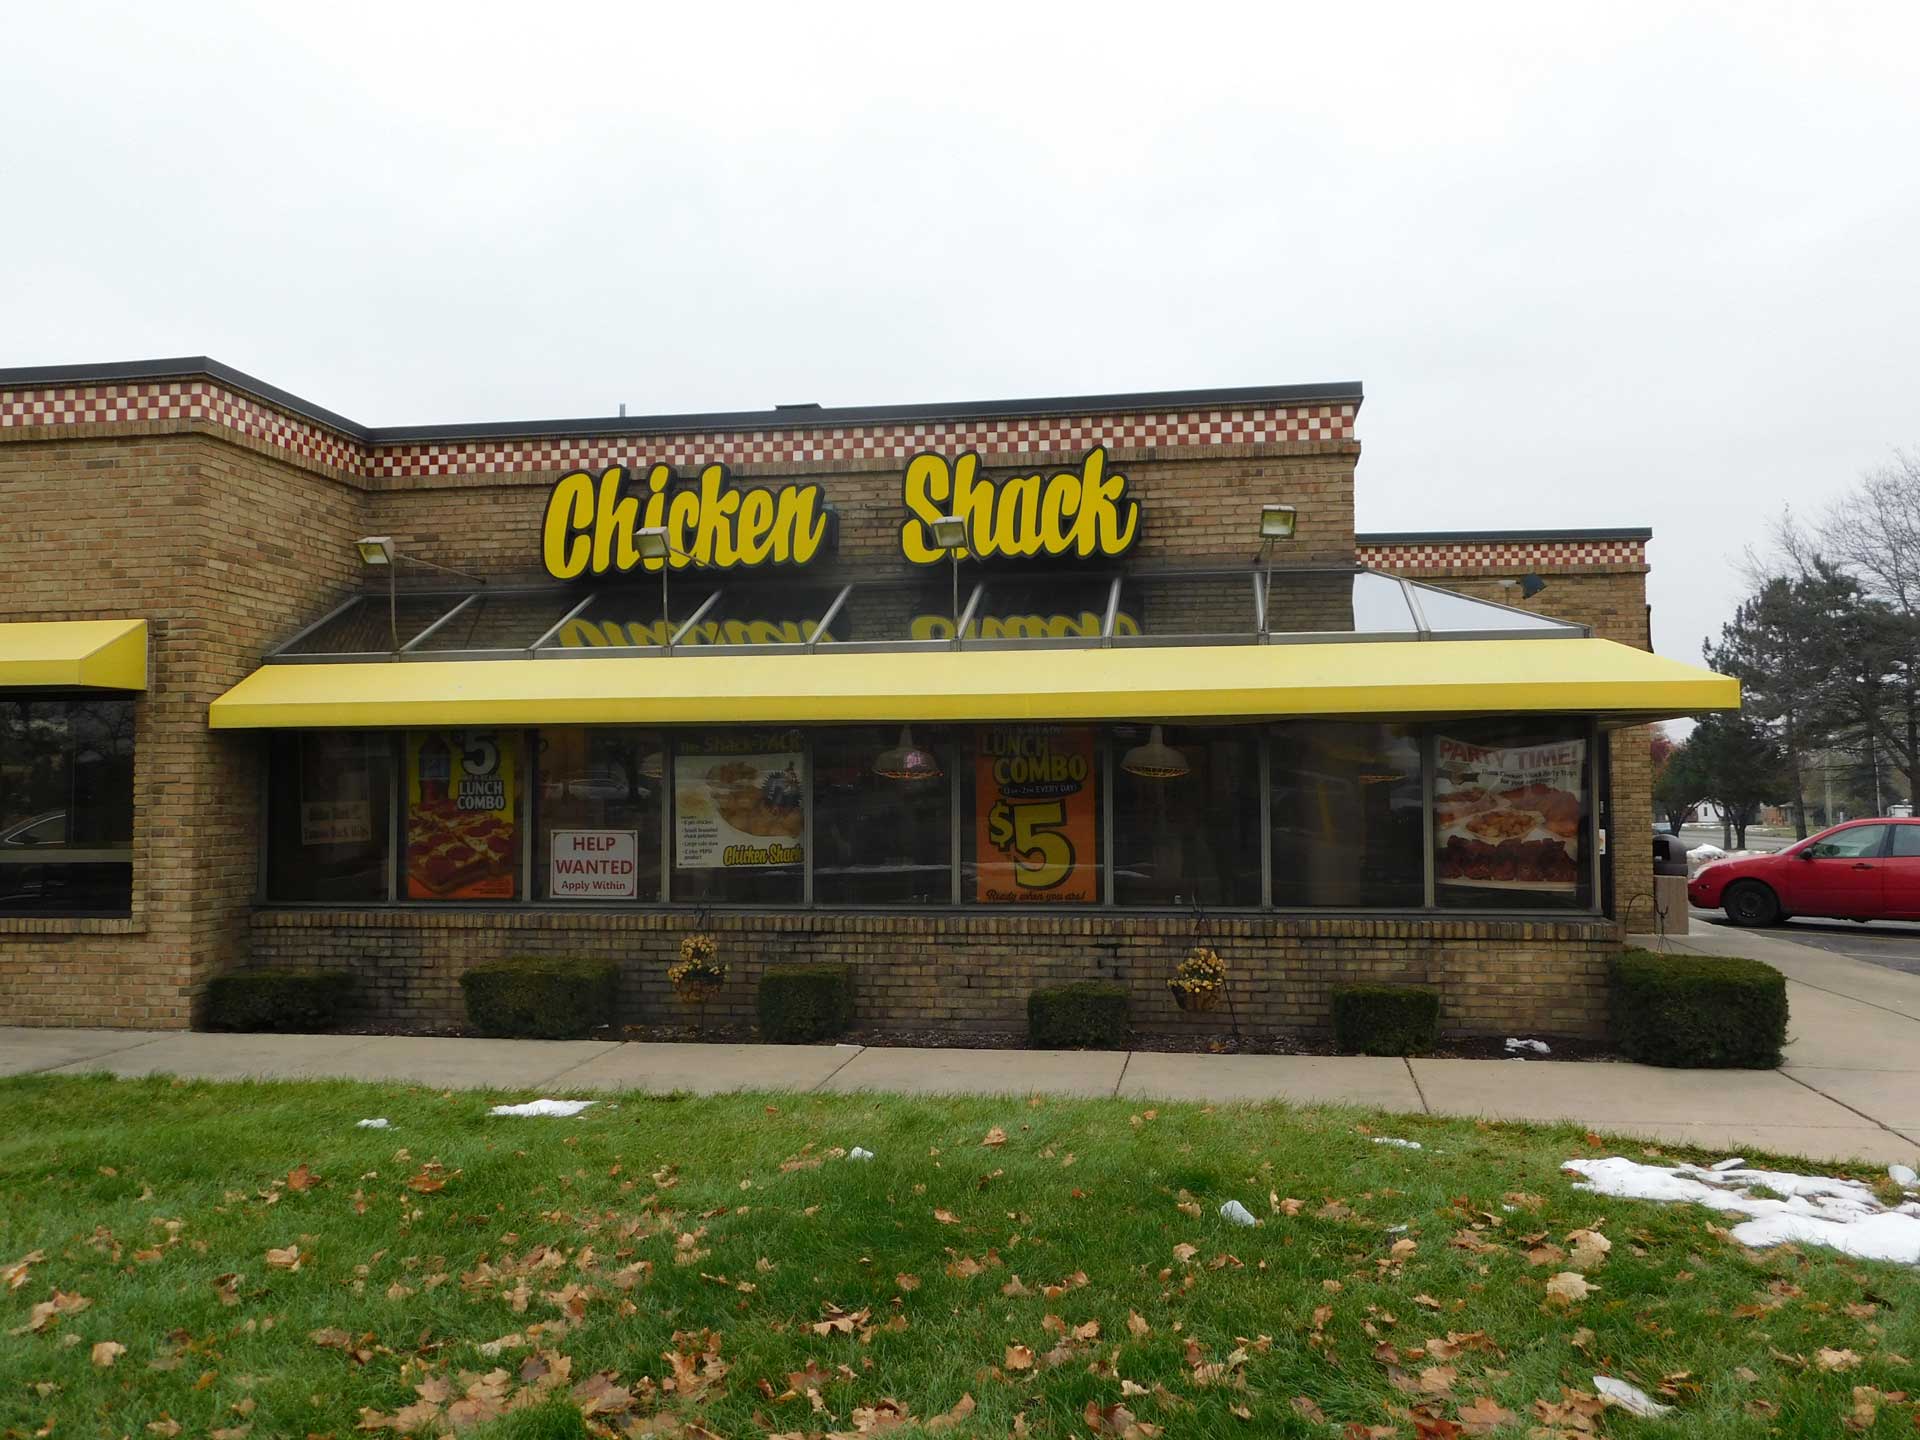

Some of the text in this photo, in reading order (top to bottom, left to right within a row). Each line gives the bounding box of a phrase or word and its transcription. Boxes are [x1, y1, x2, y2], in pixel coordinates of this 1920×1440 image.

[543, 446, 1139, 581] Chicken Shack
[981, 733, 1050, 757] LUNCH
[1440, 740, 1579, 769] PARTY TIME!
[993, 752, 1089, 785] COMBO
[457, 781, 504, 796] LUNCH
[1036, 784, 1060, 793] EVERY
[456, 796, 505, 811] COMBO
[573, 836, 616, 851] HELP
[988, 799, 1076, 890] $5
[723, 845, 768, 866] Chicken
[555, 859, 633, 875] WANTED
[561, 880, 626, 892] Apply Within
[986, 889, 1017, 901] Ready
